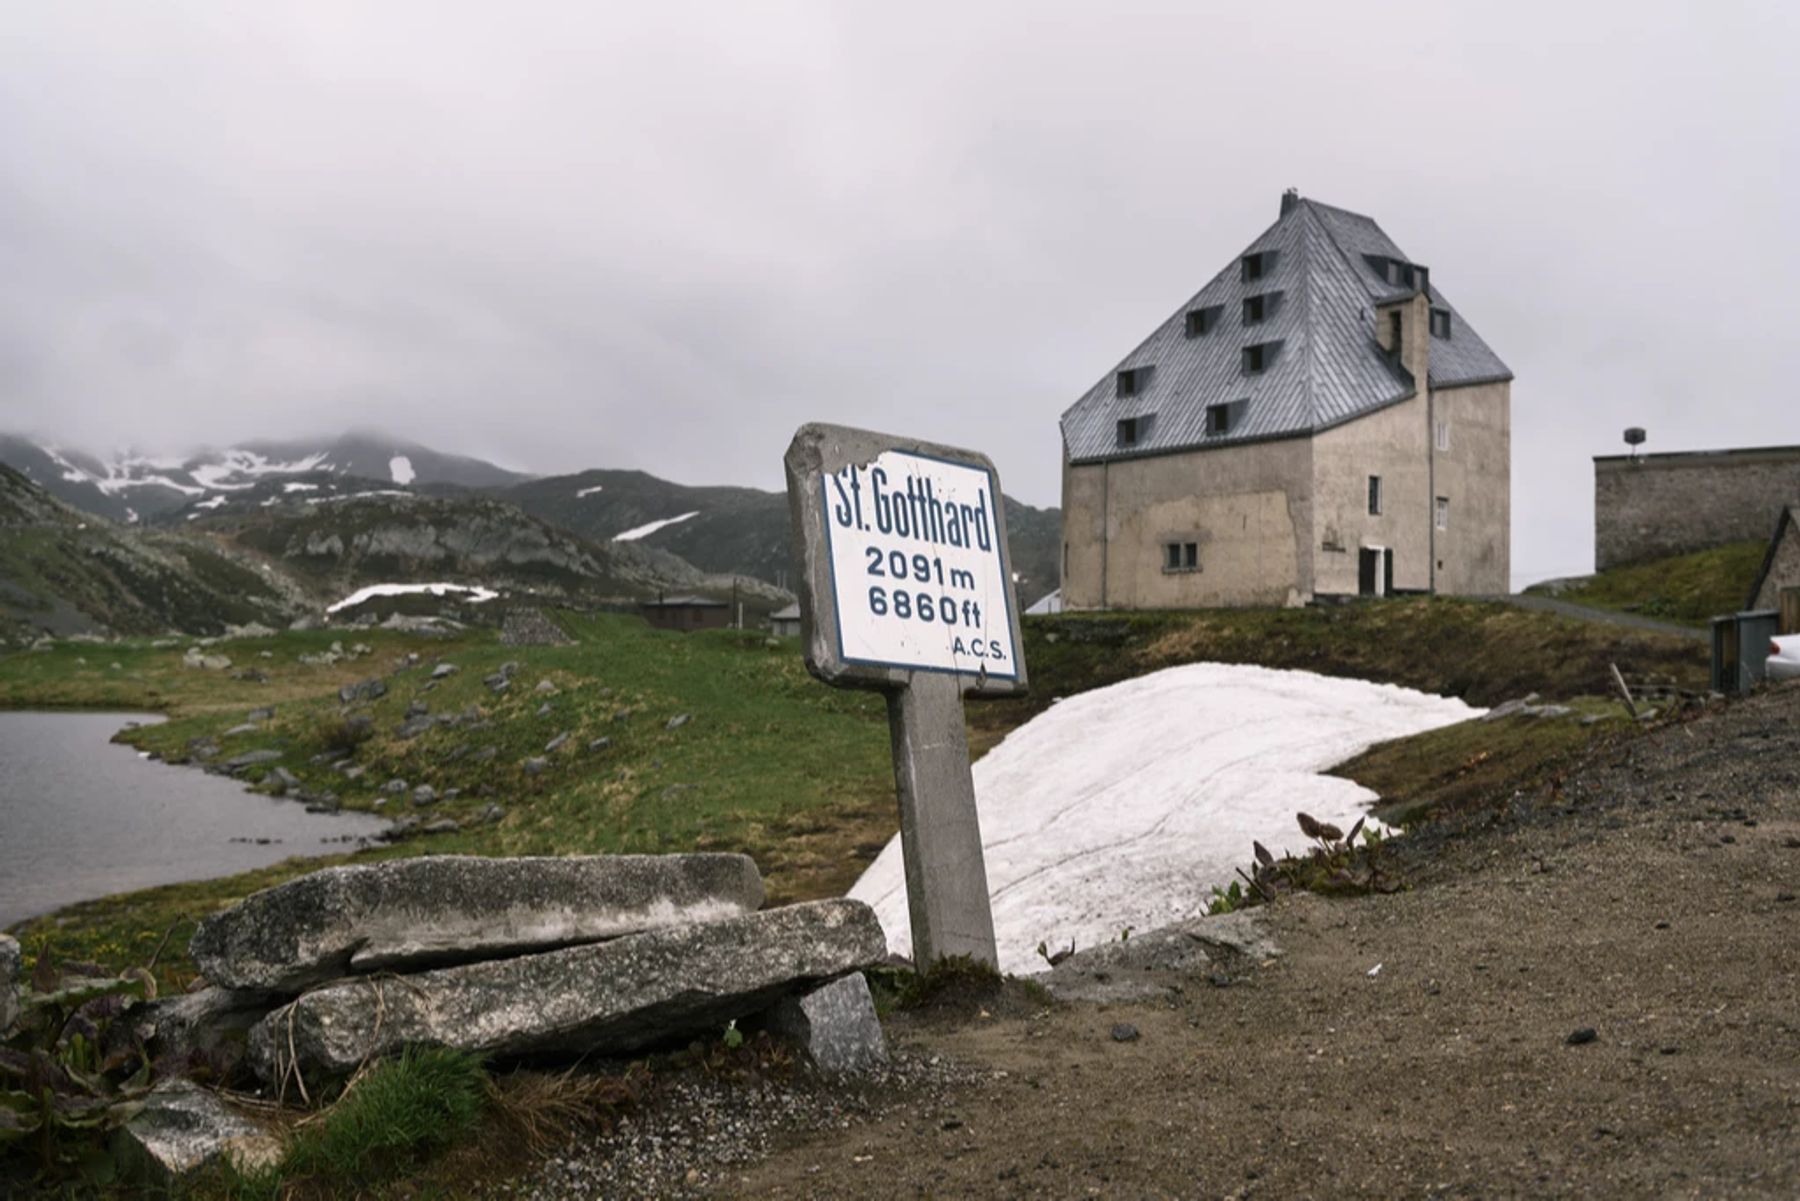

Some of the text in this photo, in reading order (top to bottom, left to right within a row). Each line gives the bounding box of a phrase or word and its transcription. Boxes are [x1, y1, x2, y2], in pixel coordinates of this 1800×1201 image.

[833, 464, 992, 553] St. Gotthard
[953, 636, 1008, 660] A.C.S.
